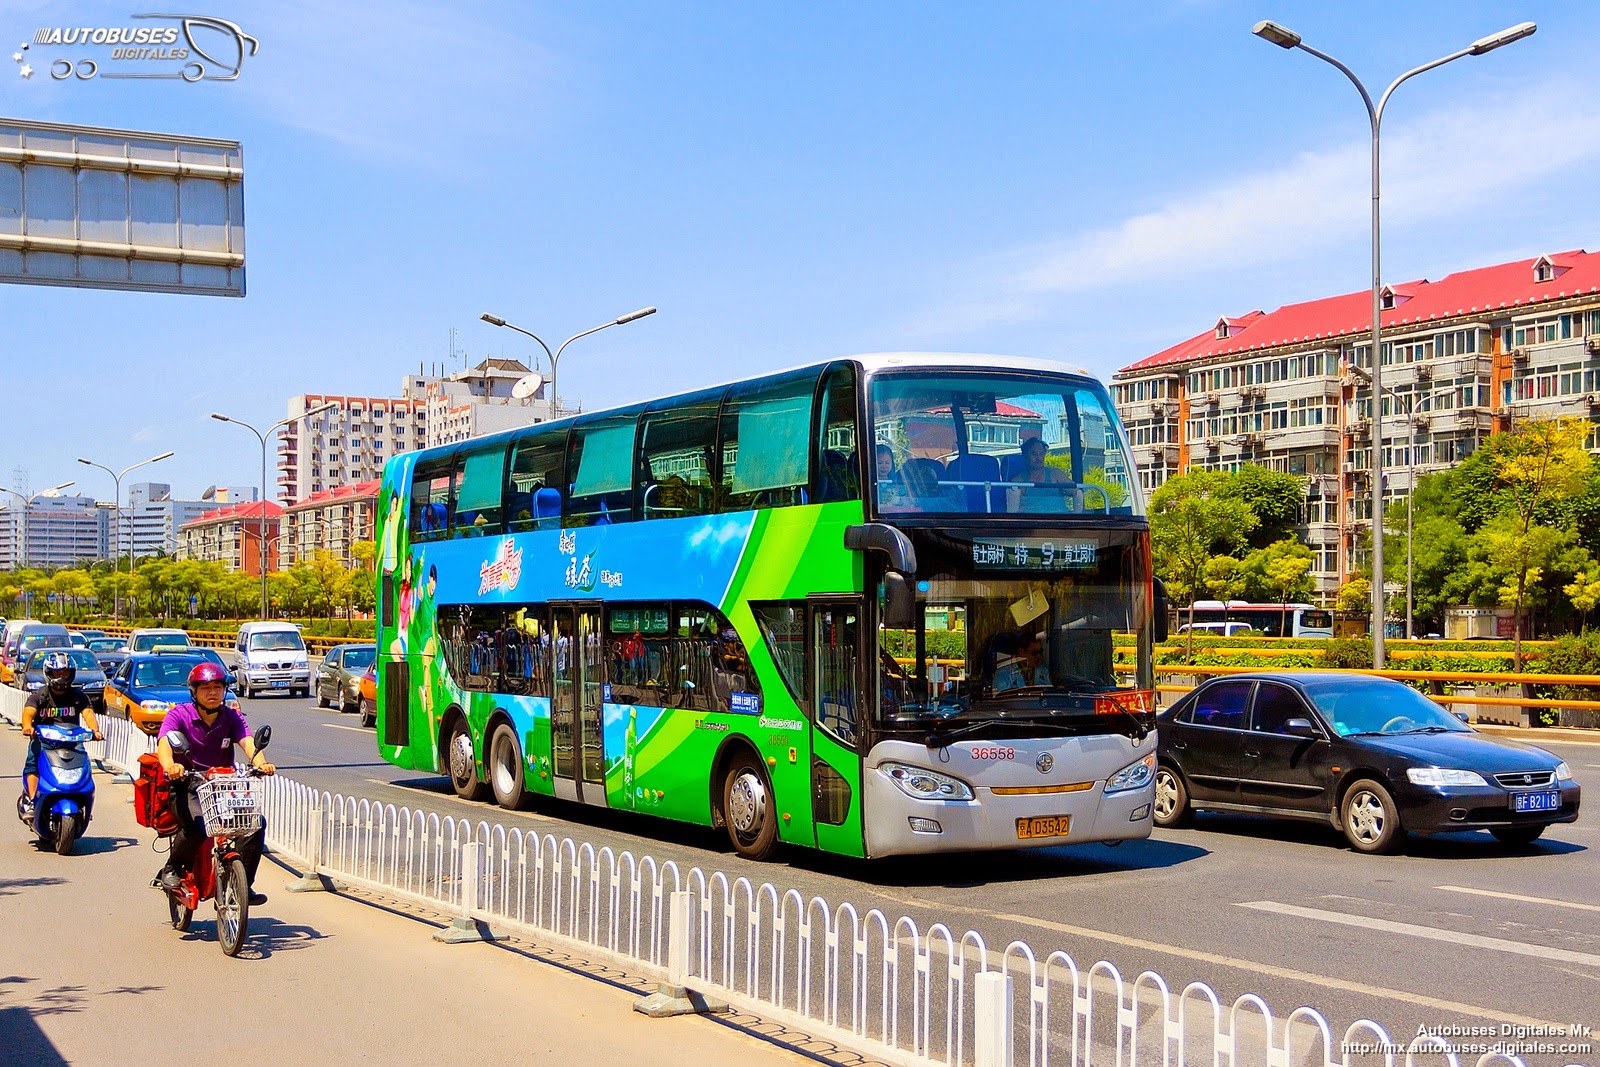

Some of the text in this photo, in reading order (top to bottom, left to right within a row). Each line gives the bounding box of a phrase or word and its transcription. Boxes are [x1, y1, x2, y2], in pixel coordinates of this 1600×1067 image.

[1014, 542, 1029, 565] 特
[1041, 542, 1054, 565] 9
[971, 747, 1015, 760] 36558
